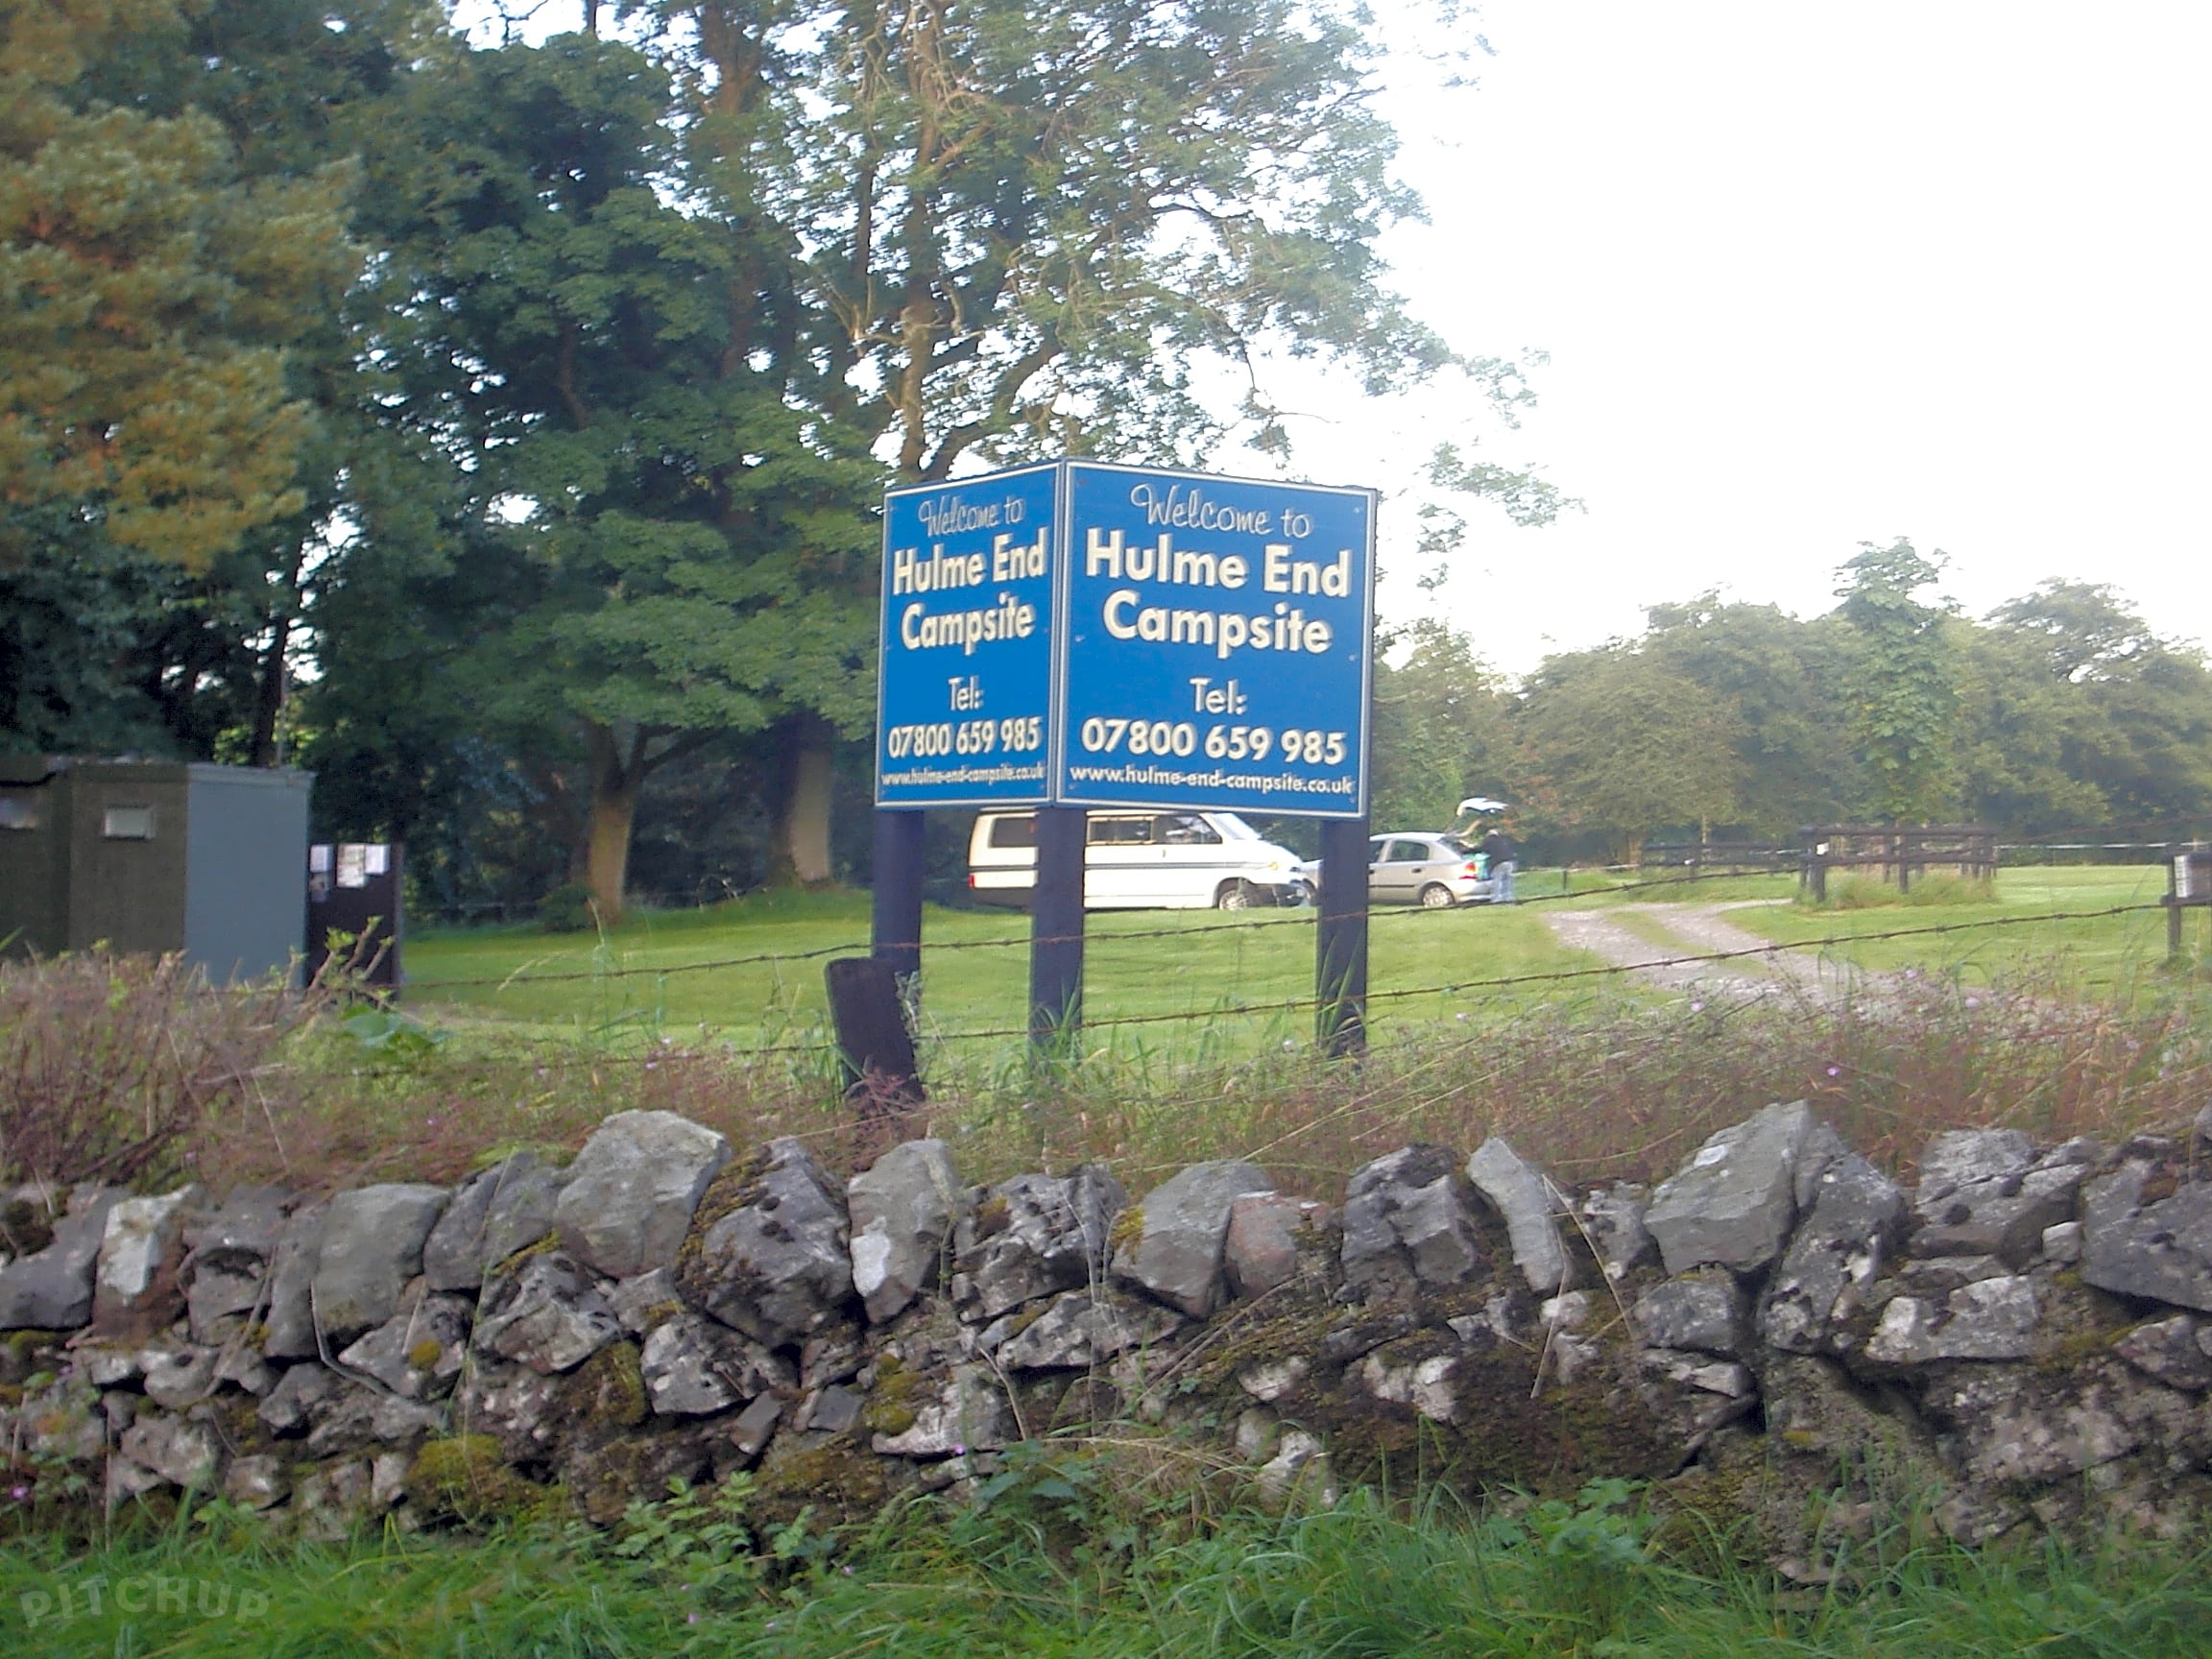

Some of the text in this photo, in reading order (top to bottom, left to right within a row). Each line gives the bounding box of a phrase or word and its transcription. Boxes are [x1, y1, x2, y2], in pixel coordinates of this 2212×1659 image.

[919, 495, 1024, 537] Welcome to
[1130, 483, 1313, 539] Welcome to
[893, 527, 1047, 594] Hulme End
[1085, 527, 1353, 597] Hulme End
[902, 592, 1035, 655] Campsite
[1102, 589, 1333, 659] Campsite
[948, 676, 983, 711] Tel:
[1190, 678, 1247, 715] Tel:
[888, 716, 1044, 758] 07800 659 985
[1081, 717, 1347, 765] 07800 659 985
[1070, 764, 1355, 794] www.hulme-end-campsite.co.uk
